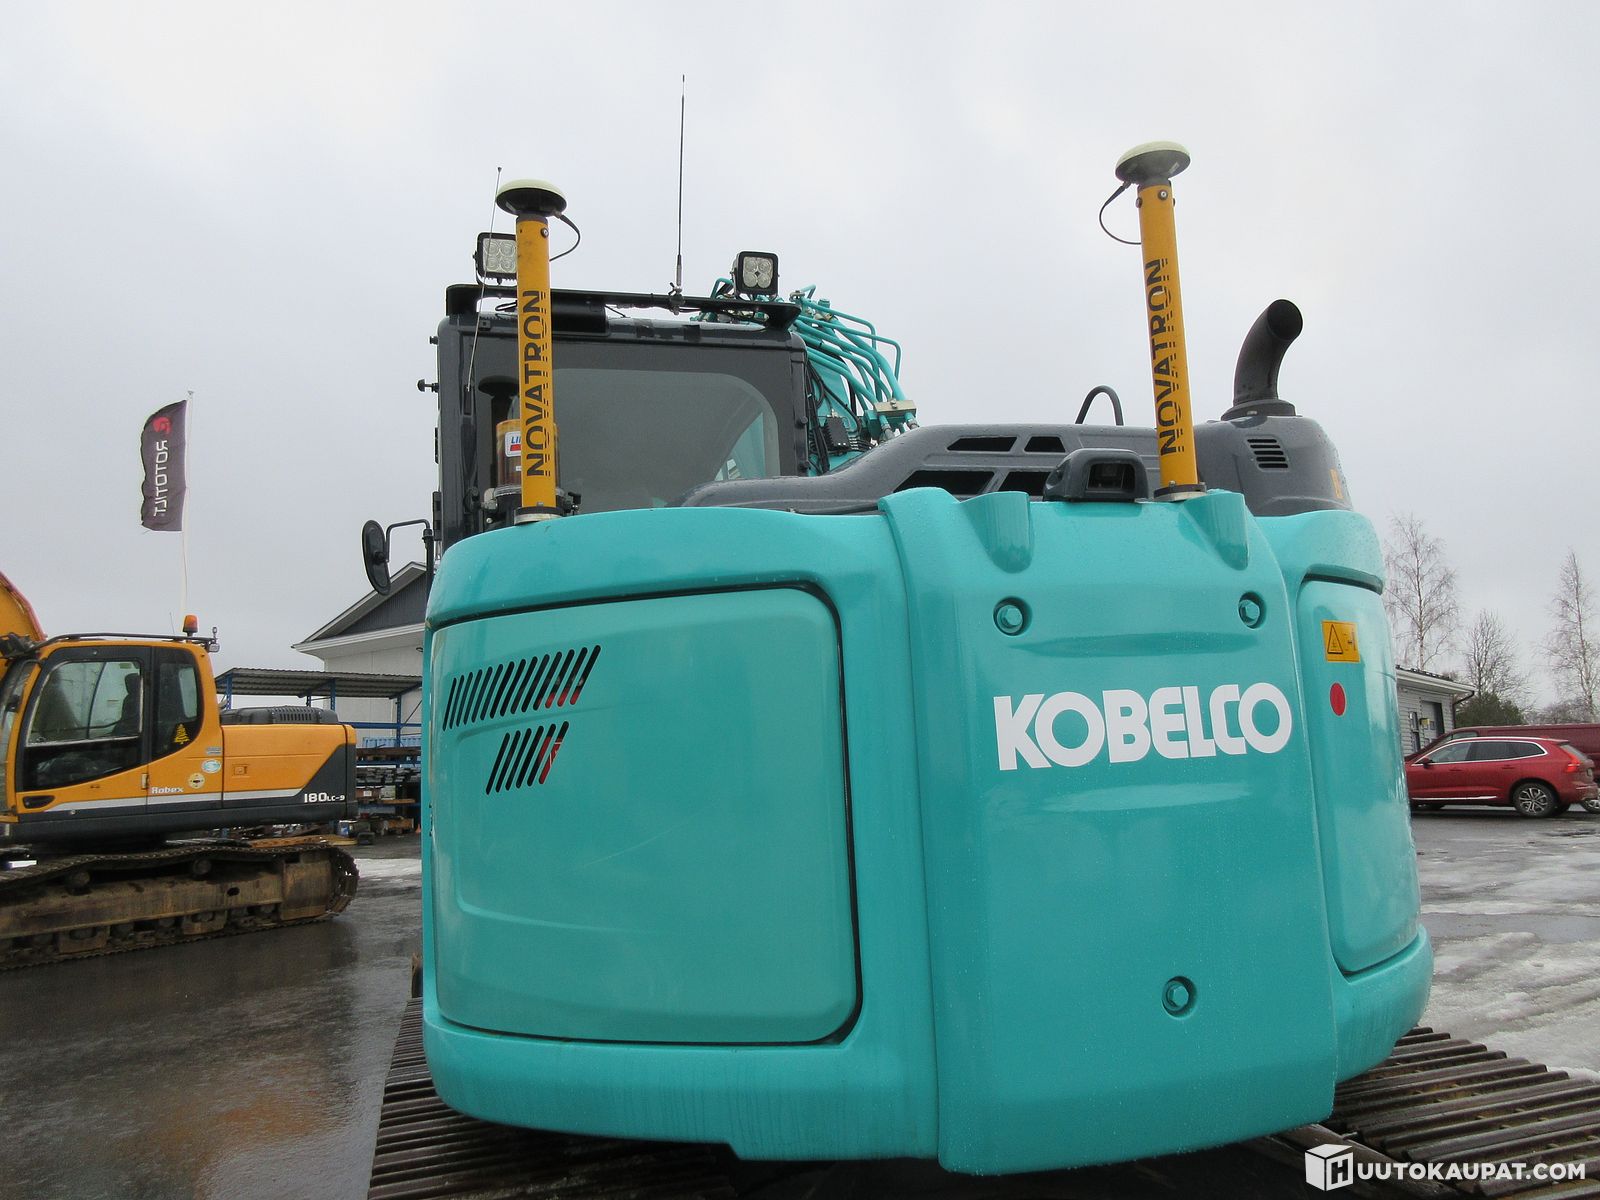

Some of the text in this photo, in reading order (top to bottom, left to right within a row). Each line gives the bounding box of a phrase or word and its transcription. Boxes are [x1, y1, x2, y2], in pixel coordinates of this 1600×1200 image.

[522, 290, 552, 477] NOVATRON
[1145, 258, 1185, 456] NOVATRON
[151, 786, 184, 794] Robex
[993, 682, 1292, 770] KOBELCO
